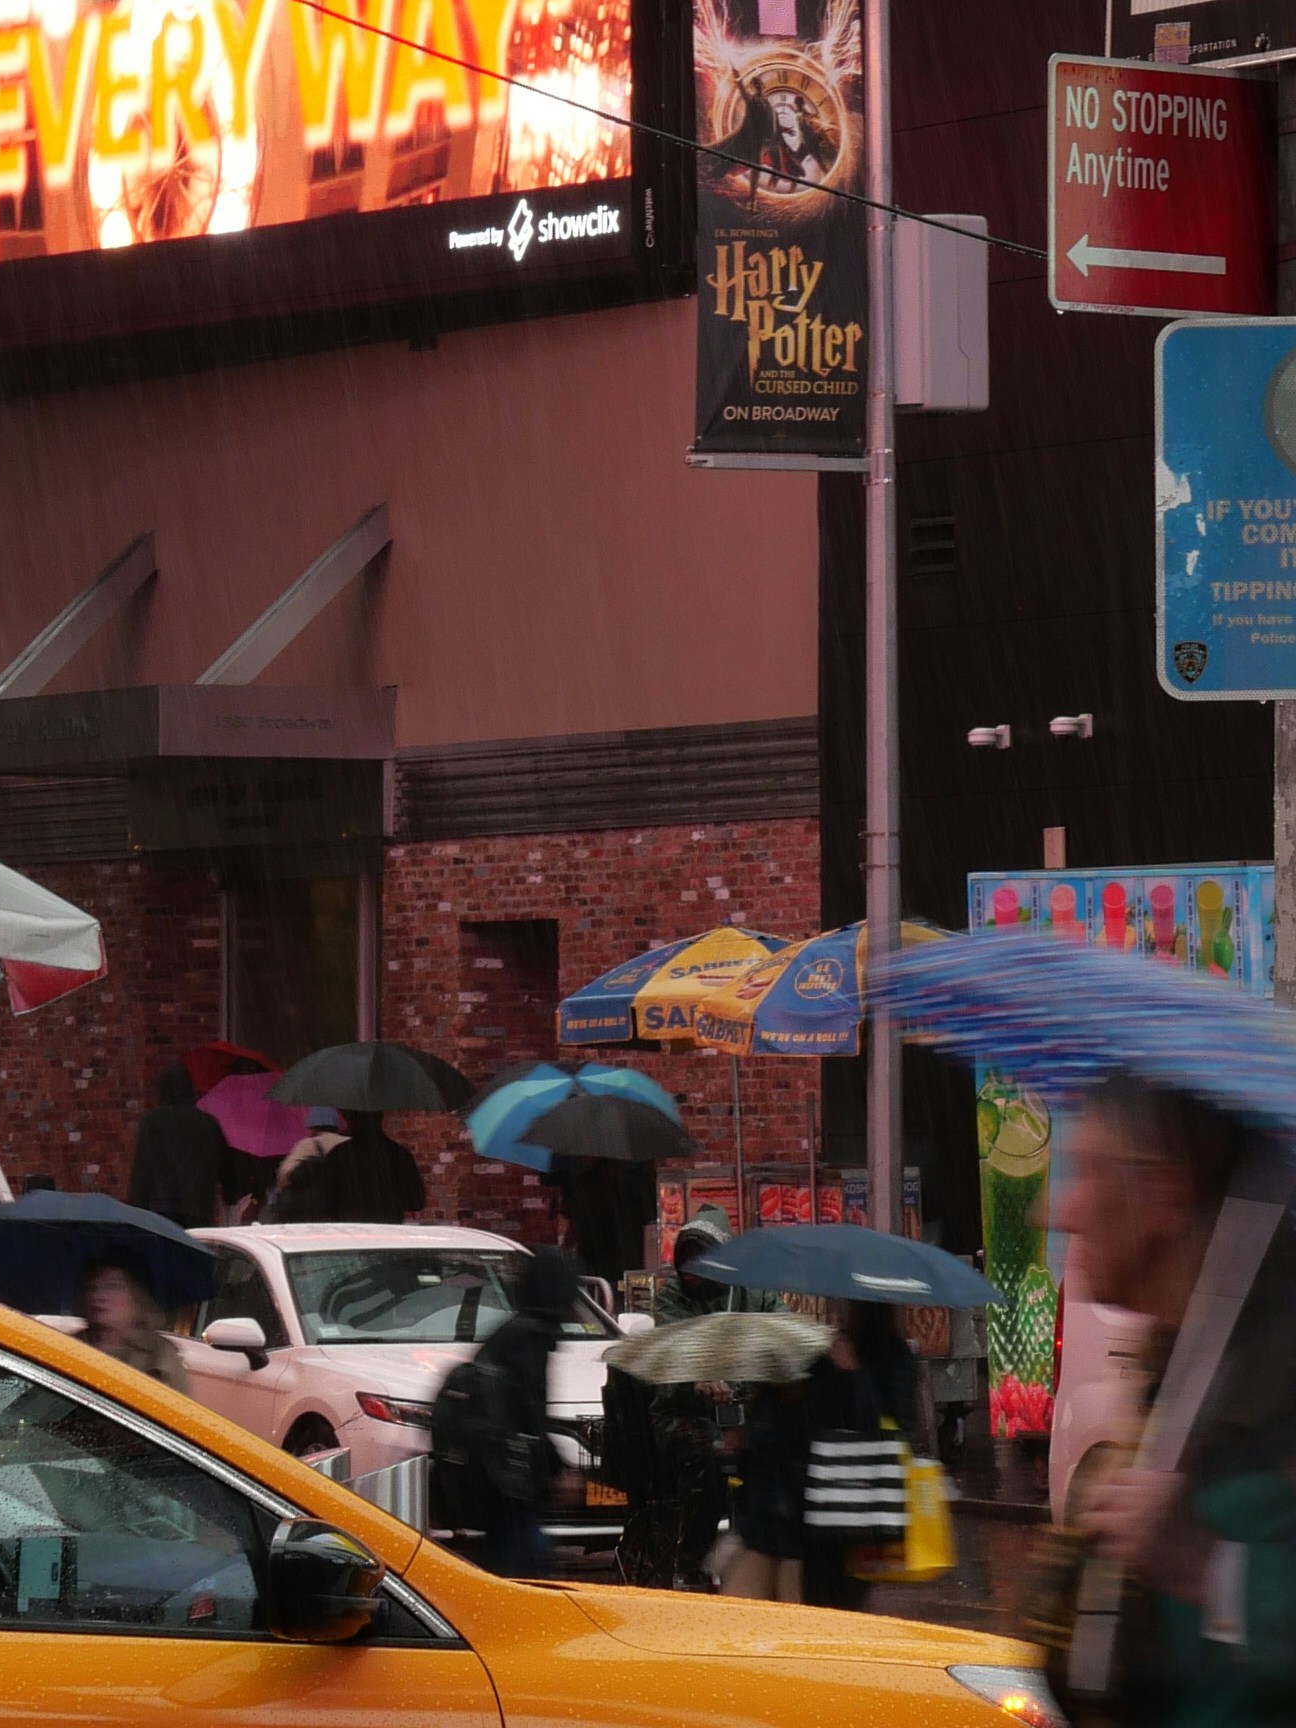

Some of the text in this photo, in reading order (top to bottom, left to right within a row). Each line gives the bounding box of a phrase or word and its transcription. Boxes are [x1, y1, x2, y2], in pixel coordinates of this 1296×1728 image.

[1065, 85, 1228, 141] NO STOPPING
[1065, 142, 1171, 198] Anytime
[537, 204, 620, 243] showclix
[449, 227, 505, 250] Powered by
[705, 240, 824, 322] Harry
[746, 299, 863, 389] Potter
[755, 380, 859, 395] CURSED CHILD
[723, 405, 840, 422] ON BROADWAY
[1206, 500, 1231, 521] IF
[1212, 613, 1224, 626] If
[1227, 616, 1253, 629] you
[1257, 613, 1293, 625] have
[1250, 632, 1296, 645] Police
[760, 1030, 788, 1043] WE'RE
[792, 1032, 806, 1043] ON
[806, 1032, 815, 1043] A
[816, 1031, 836, 1043] ROLL
